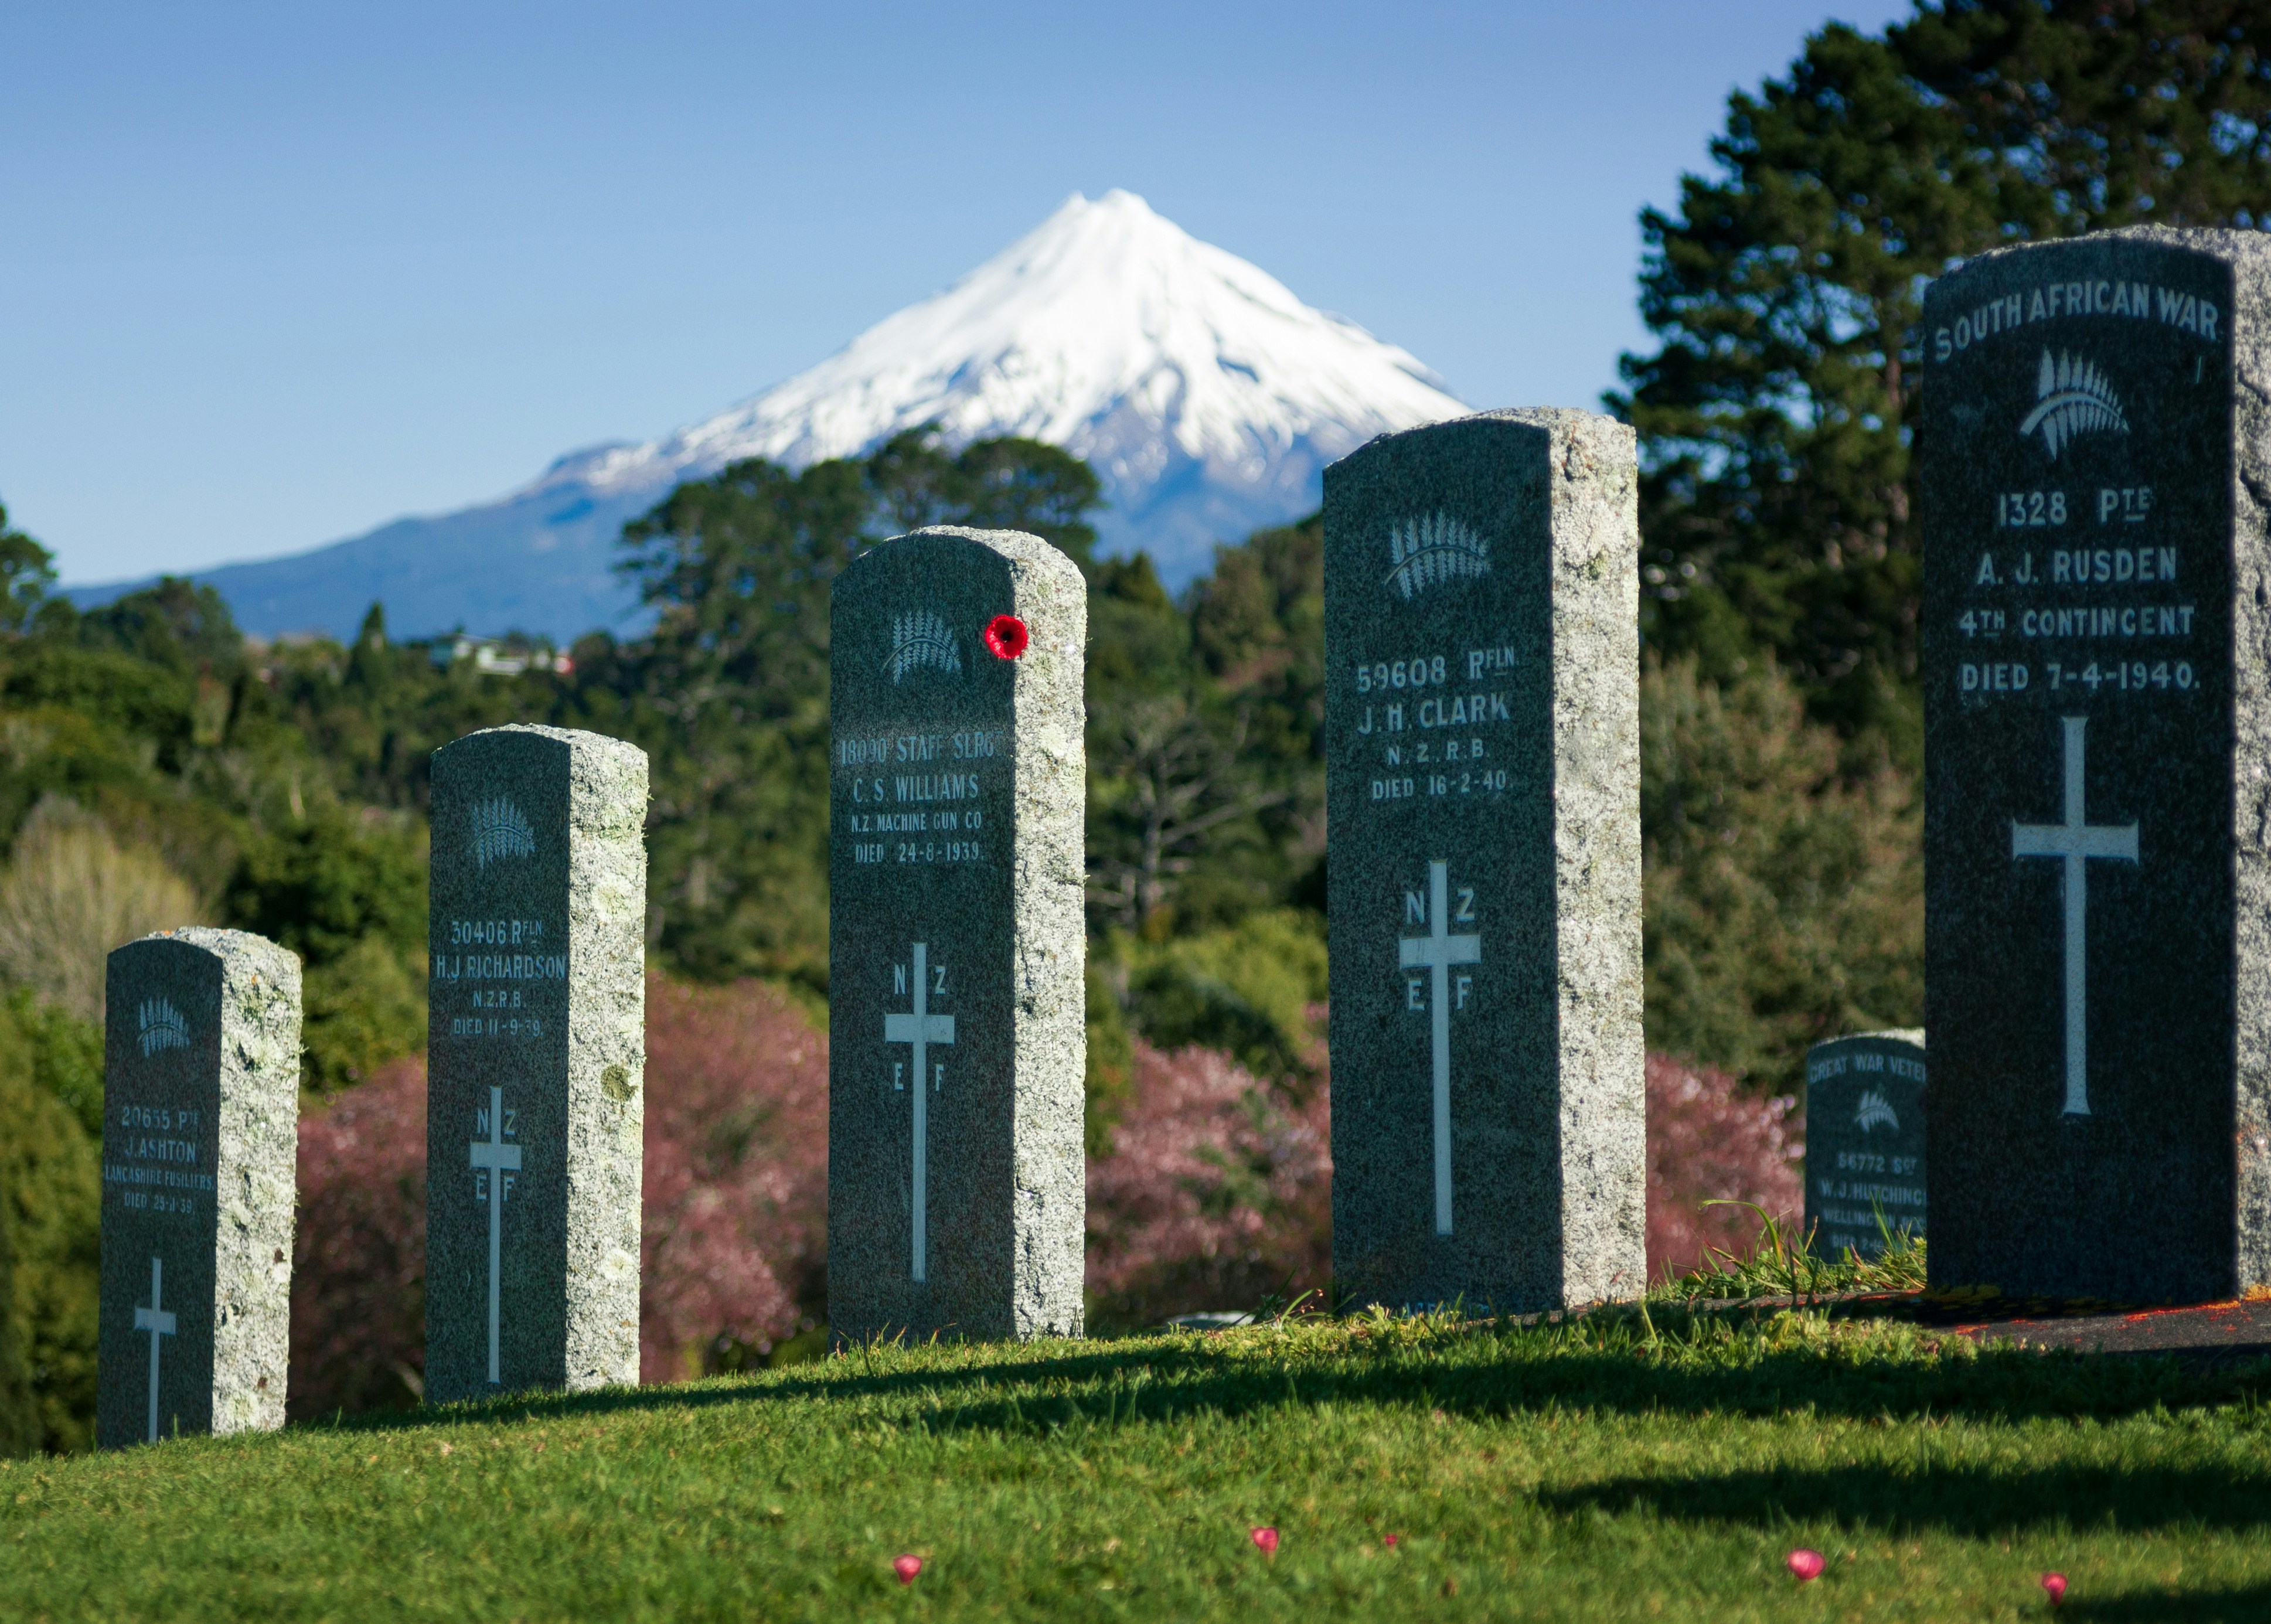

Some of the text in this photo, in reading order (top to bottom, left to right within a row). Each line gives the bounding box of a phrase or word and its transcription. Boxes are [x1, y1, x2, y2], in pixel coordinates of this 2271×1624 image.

[1935, 281, 2219, 361] SOUTH AFRICAN WAR
[2000, 491, 2067, 526] 1328
[2054, 546, 2176, 584] RUSDEN
[1959, 605, 2195, 639] 4TH CONTINGENT
[1357, 655, 1446, 693] 59608
[1961, 661, 2200, 692] DIED 7-4-1940.
[1419, 692, 1510, 728] CLARK
[842, 737, 887, 765] 18090
[897, 734, 944, 762] STAFF
[896, 774, 979, 802] WILLIAMS
[1373, 777, 1415, 801] DIED
[877, 813, 926, 832] MACHINE
[933, 811, 957, 830] GUN
[855, 843, 884, 863] DIED
[1407, 887, 1475, 925] N Z
[451, 920, 506, 945] 30406
[467, 954, 566, 979] RICHARDSON
[894, 963, 946, 995] N Z
[1408, 975, 1472, 1011] E F
[454, 1018, 482, 1036] DIED
[894, 1062, 945, 1092] E F
[1809, 1056, 1848, 1084] GREAT
[1854, 1053, 1885, 1073] WAR
[477, 1107, 516, 1135] N Z
[104, 1165, 162, 1185] LANCASHIRE
[476, 1174, 515, 1202] E F
[124, 1191, 148, 1208] DIED
